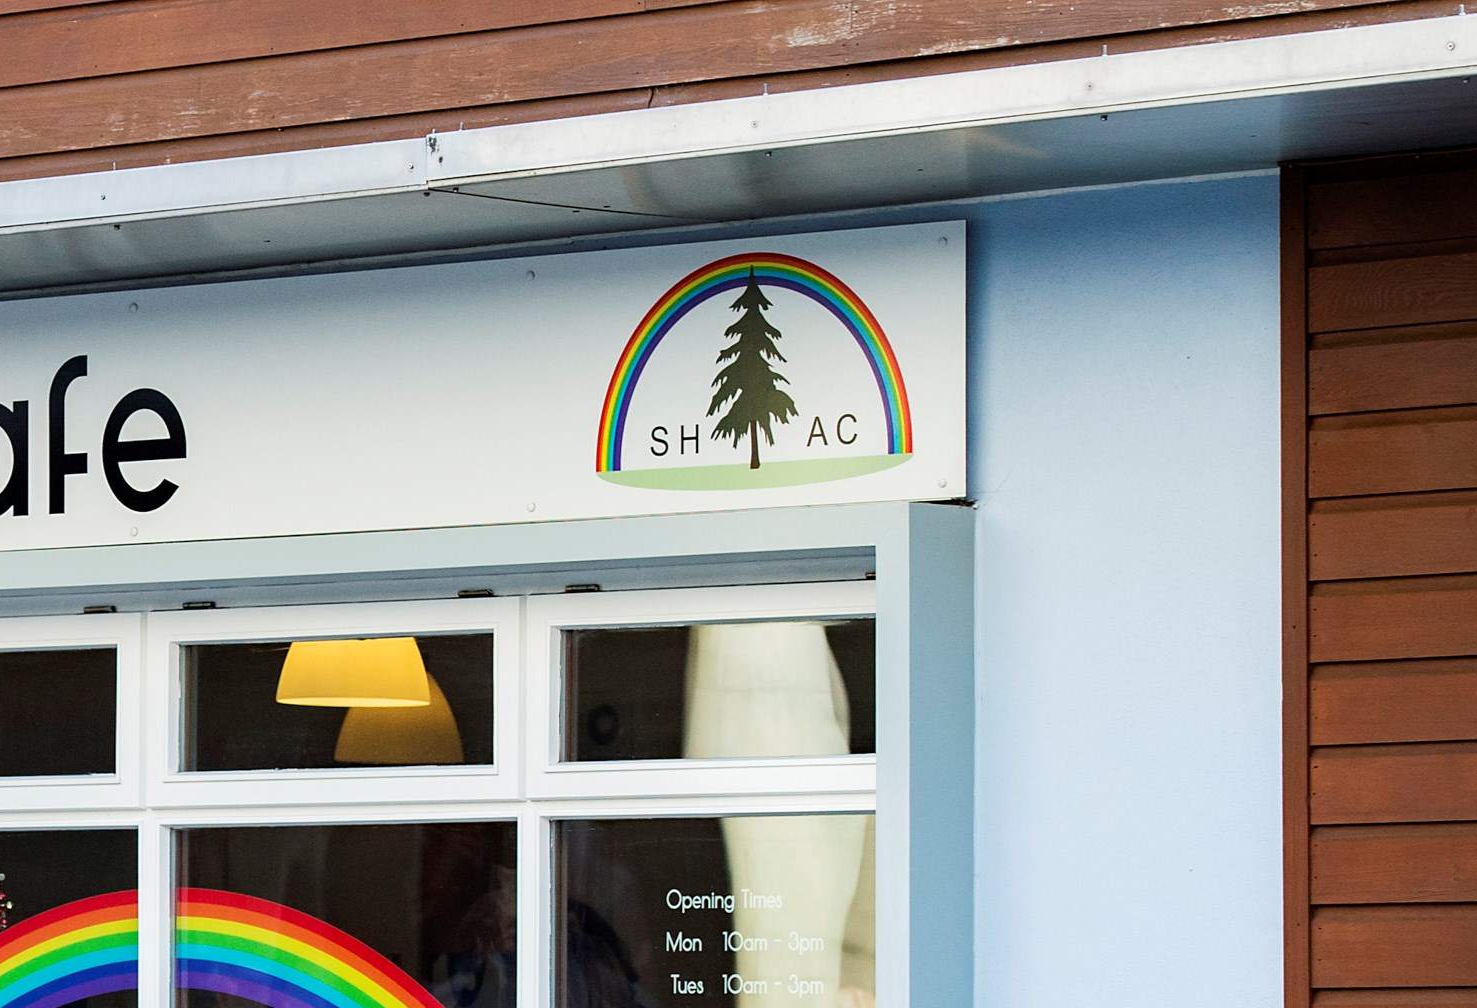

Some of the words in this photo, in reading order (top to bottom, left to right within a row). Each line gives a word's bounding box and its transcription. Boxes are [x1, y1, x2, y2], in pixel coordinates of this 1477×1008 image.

[650, 424, 700, 457] SH
[806, 413, 858, 448] AC
[666, 888, 735, 913] Opening
[741, 888, 783, 908] Times
[665, 931, 702, 953] Mon
[721, 931, 767, 953] 10am
[787, 931, 824, 955] 3pm
[670, 973, 704, 995] Tues
[721, 973, 767, 995] 10am
[787, 973, 824, 998] 3pm
